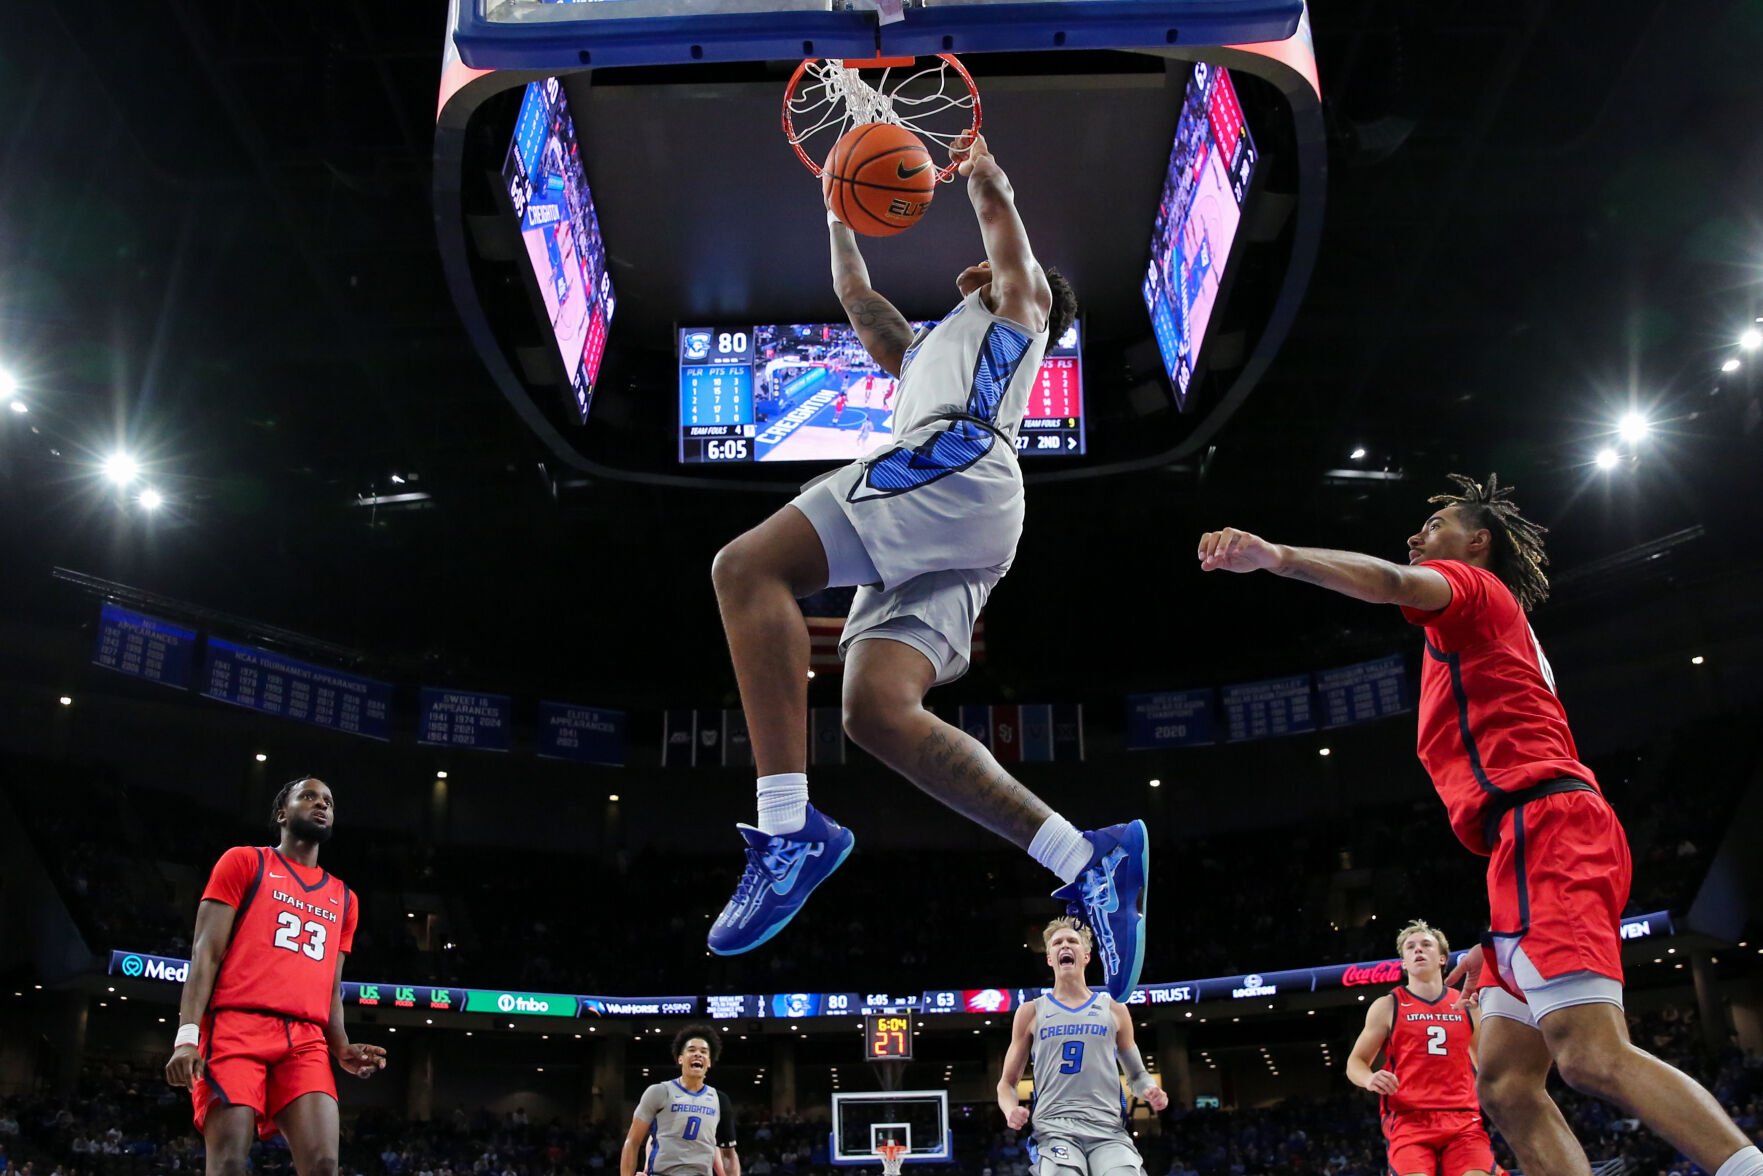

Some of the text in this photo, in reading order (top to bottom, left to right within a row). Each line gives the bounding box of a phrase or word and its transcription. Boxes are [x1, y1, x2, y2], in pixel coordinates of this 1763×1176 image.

[718, 333, 747, 353] 80
[692, 406, 697, 414] 4
[755, 390, 839, 444] CREIGHTON
[691, 425, 741, 435] TEAM FOULS 4
[1024, 418, 1075, 428] TEAM FOULS 9
[1015, 436, 1060, 449] 27 2ND
[708, 440, 747, 460] 6:05
[235, 652, 367, 693] NCAA TOURNAMENT APPEARANCES
[444, 694, 475, 705] SWEET
[432, 703, 499, 717] APPEARANCES
[568, 710, 590, 720] ELITE
[430, 712, 447, 721] 1941
[456, 714, 474, 724] 1974
[550, 716, 615, 732] APPEARANCES
[454, 724, 474, 734] 2021
[560, 728, 576, 737] 1941
[1155, 725, 1186, 738] 2020
[273, 890, 336, 923] UTAH TECH
[274, 911, 326, 961] 23
[144, 959, 189, 982] Med
[516, 997, 548, 1012] fnbo
[828, 995, 848, 1009] 80
[867, 994, 888, 1006] 6:05
[907, 996, 916, 1005] 27
[937, 993, 955, 1006] 63
[1407, 1013, 1433, 1021] UTAH
[878, 1018, 907, 1031] 6:04
[1040, 1024, 1107, 1040] CREIGHTON
[874, 1032, 904, 1055] 27
[1427, 1026, 1447, 1055] 2
[1059, 1041, 1084, 1074] 9
[672, 1104, 716, 1116] CREIGHTON
[682, 1116, 701, 1140] 0
